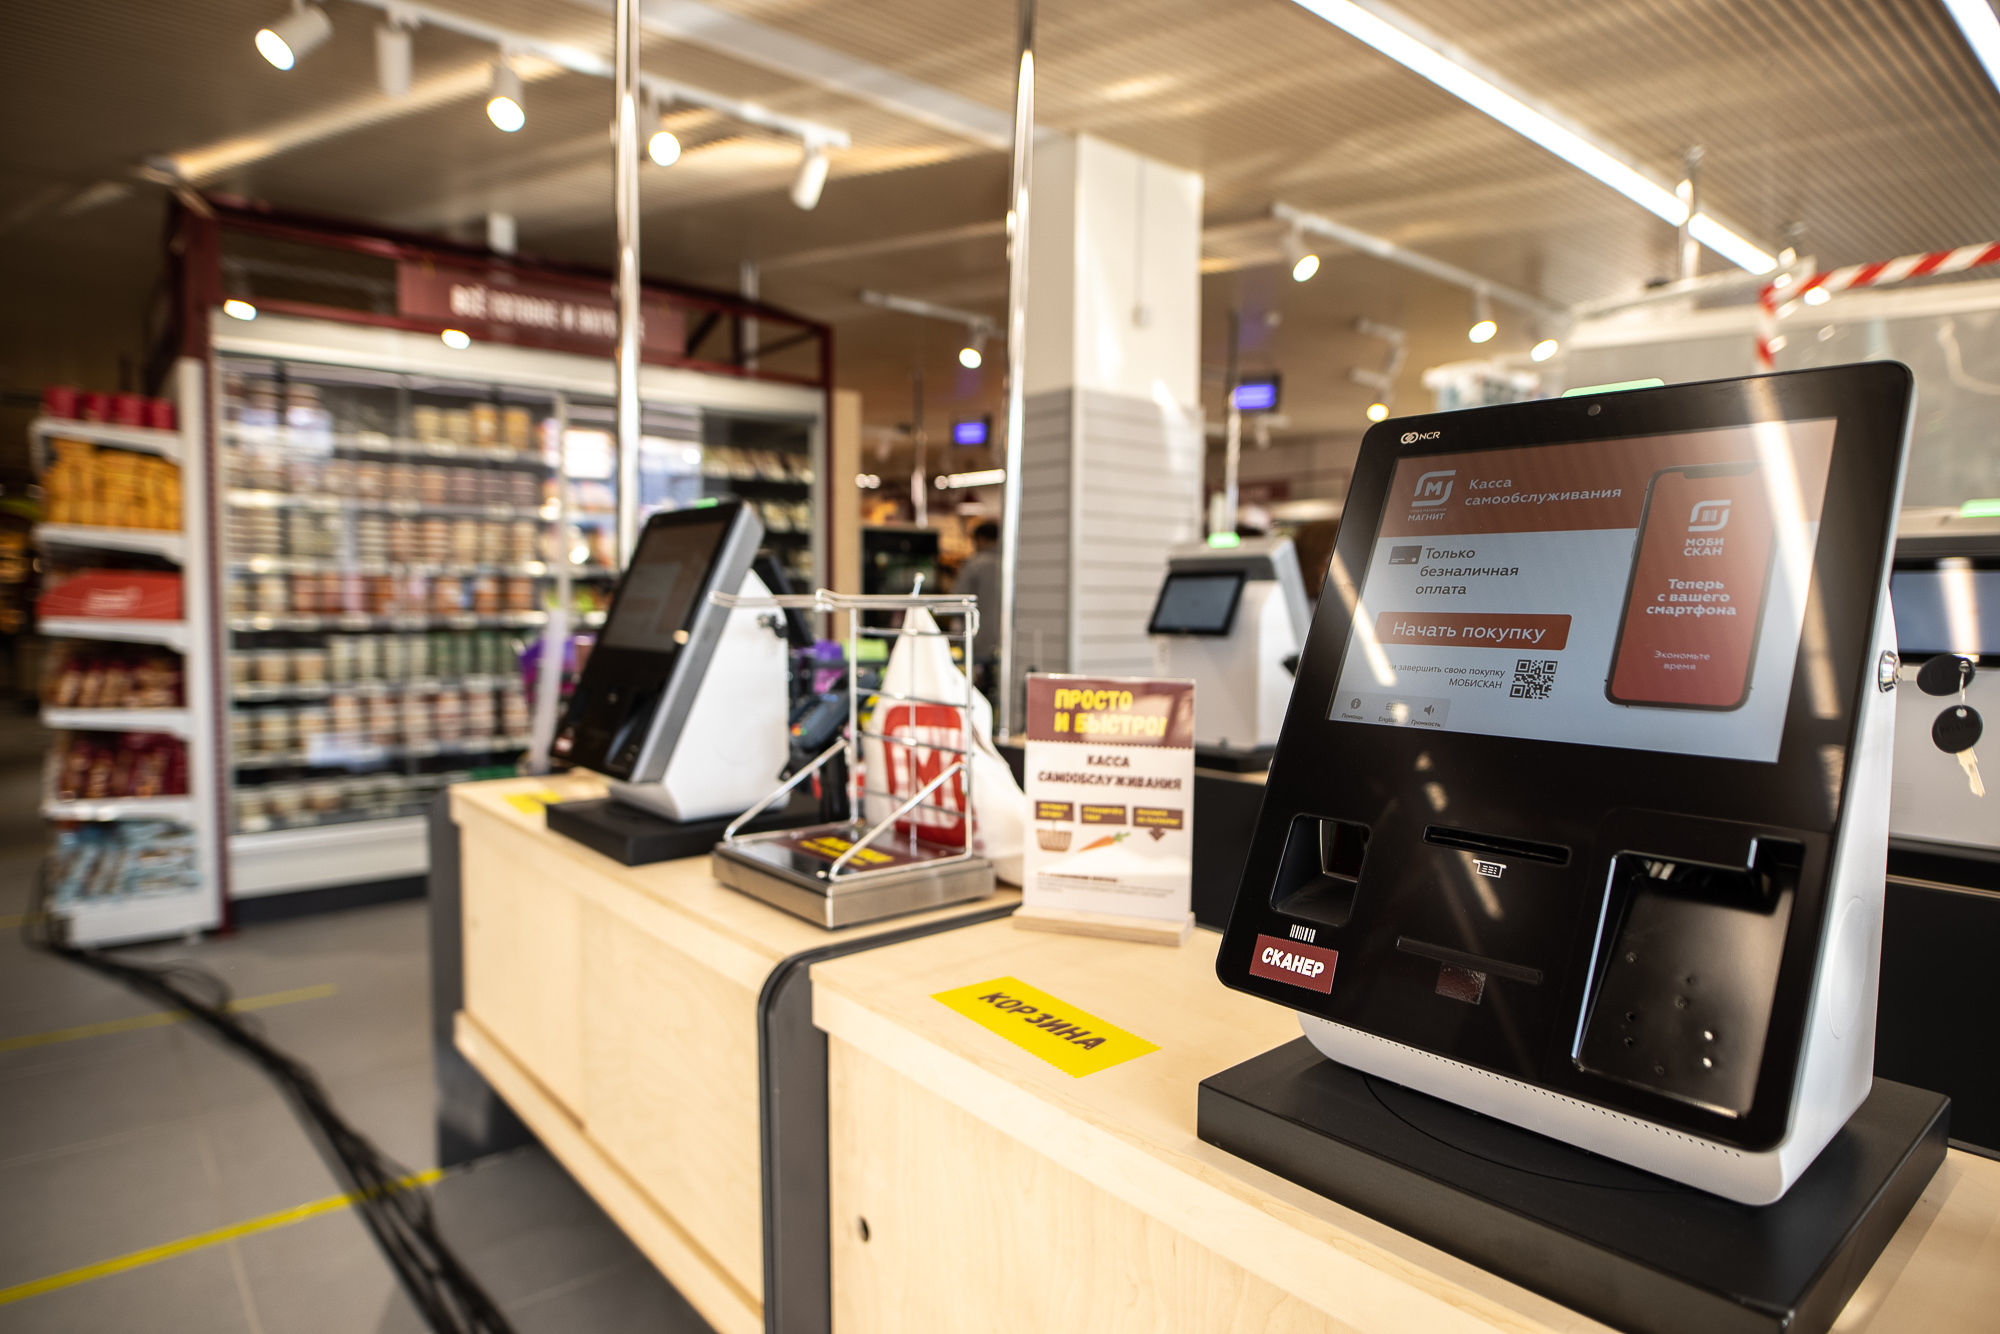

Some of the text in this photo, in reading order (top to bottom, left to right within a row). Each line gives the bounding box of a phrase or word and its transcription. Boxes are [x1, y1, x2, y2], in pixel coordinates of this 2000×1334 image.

[1419, 431, 1441, 441] NCR
[1469, 479, 1512, 490] Касса
[1465, 488, 1622, 506] самообслуживания
[1407, 513, 1446, 522] МАГНИТ
[1685, 538, 1724, 547] МОБИ
[1425, 547, 1476, 560] Только
[1683, 547, 1723, 557] СКАН
[1419, 565, 1519, 577] безналичная
[1415, 585, 1467, 595] оплата
[1668, 578, 1725, 591] Теперь
[1657, 593, 1731, 603] с вашего
[1646, 604, 1737, 617] смартфона
[1392, 621, 1546, 644] Начать покупку
[1654, 650, 1711, 661] Экономьте
[1398, 663, 1442, 675] завершить
[1444, 666, 1467, 675] свою
[1468, 668, 1506, 679] покупку
[1663, 662, 1697, 672] время
[1448, 678, 1503, 689] МОБИСКАН
[1054, 688, 1134, 712] ПРОСТО
[1341, 712, 1364, 721] Помощь
[1378, 716, 1399, 725] English
[1053, 711, 1168, 737] И БЫСТРО!
[1411, 719, 1441, 728] Громкость
[1087, 754, 1130, 769] КАССА
[1037, 770, 1182, 790] САМООБСЛУЖИВАНИЯ
[1261, 946, 1325, 978] СКАНЕР
[977, 991, 1107, 1051] КОРЗИНА
